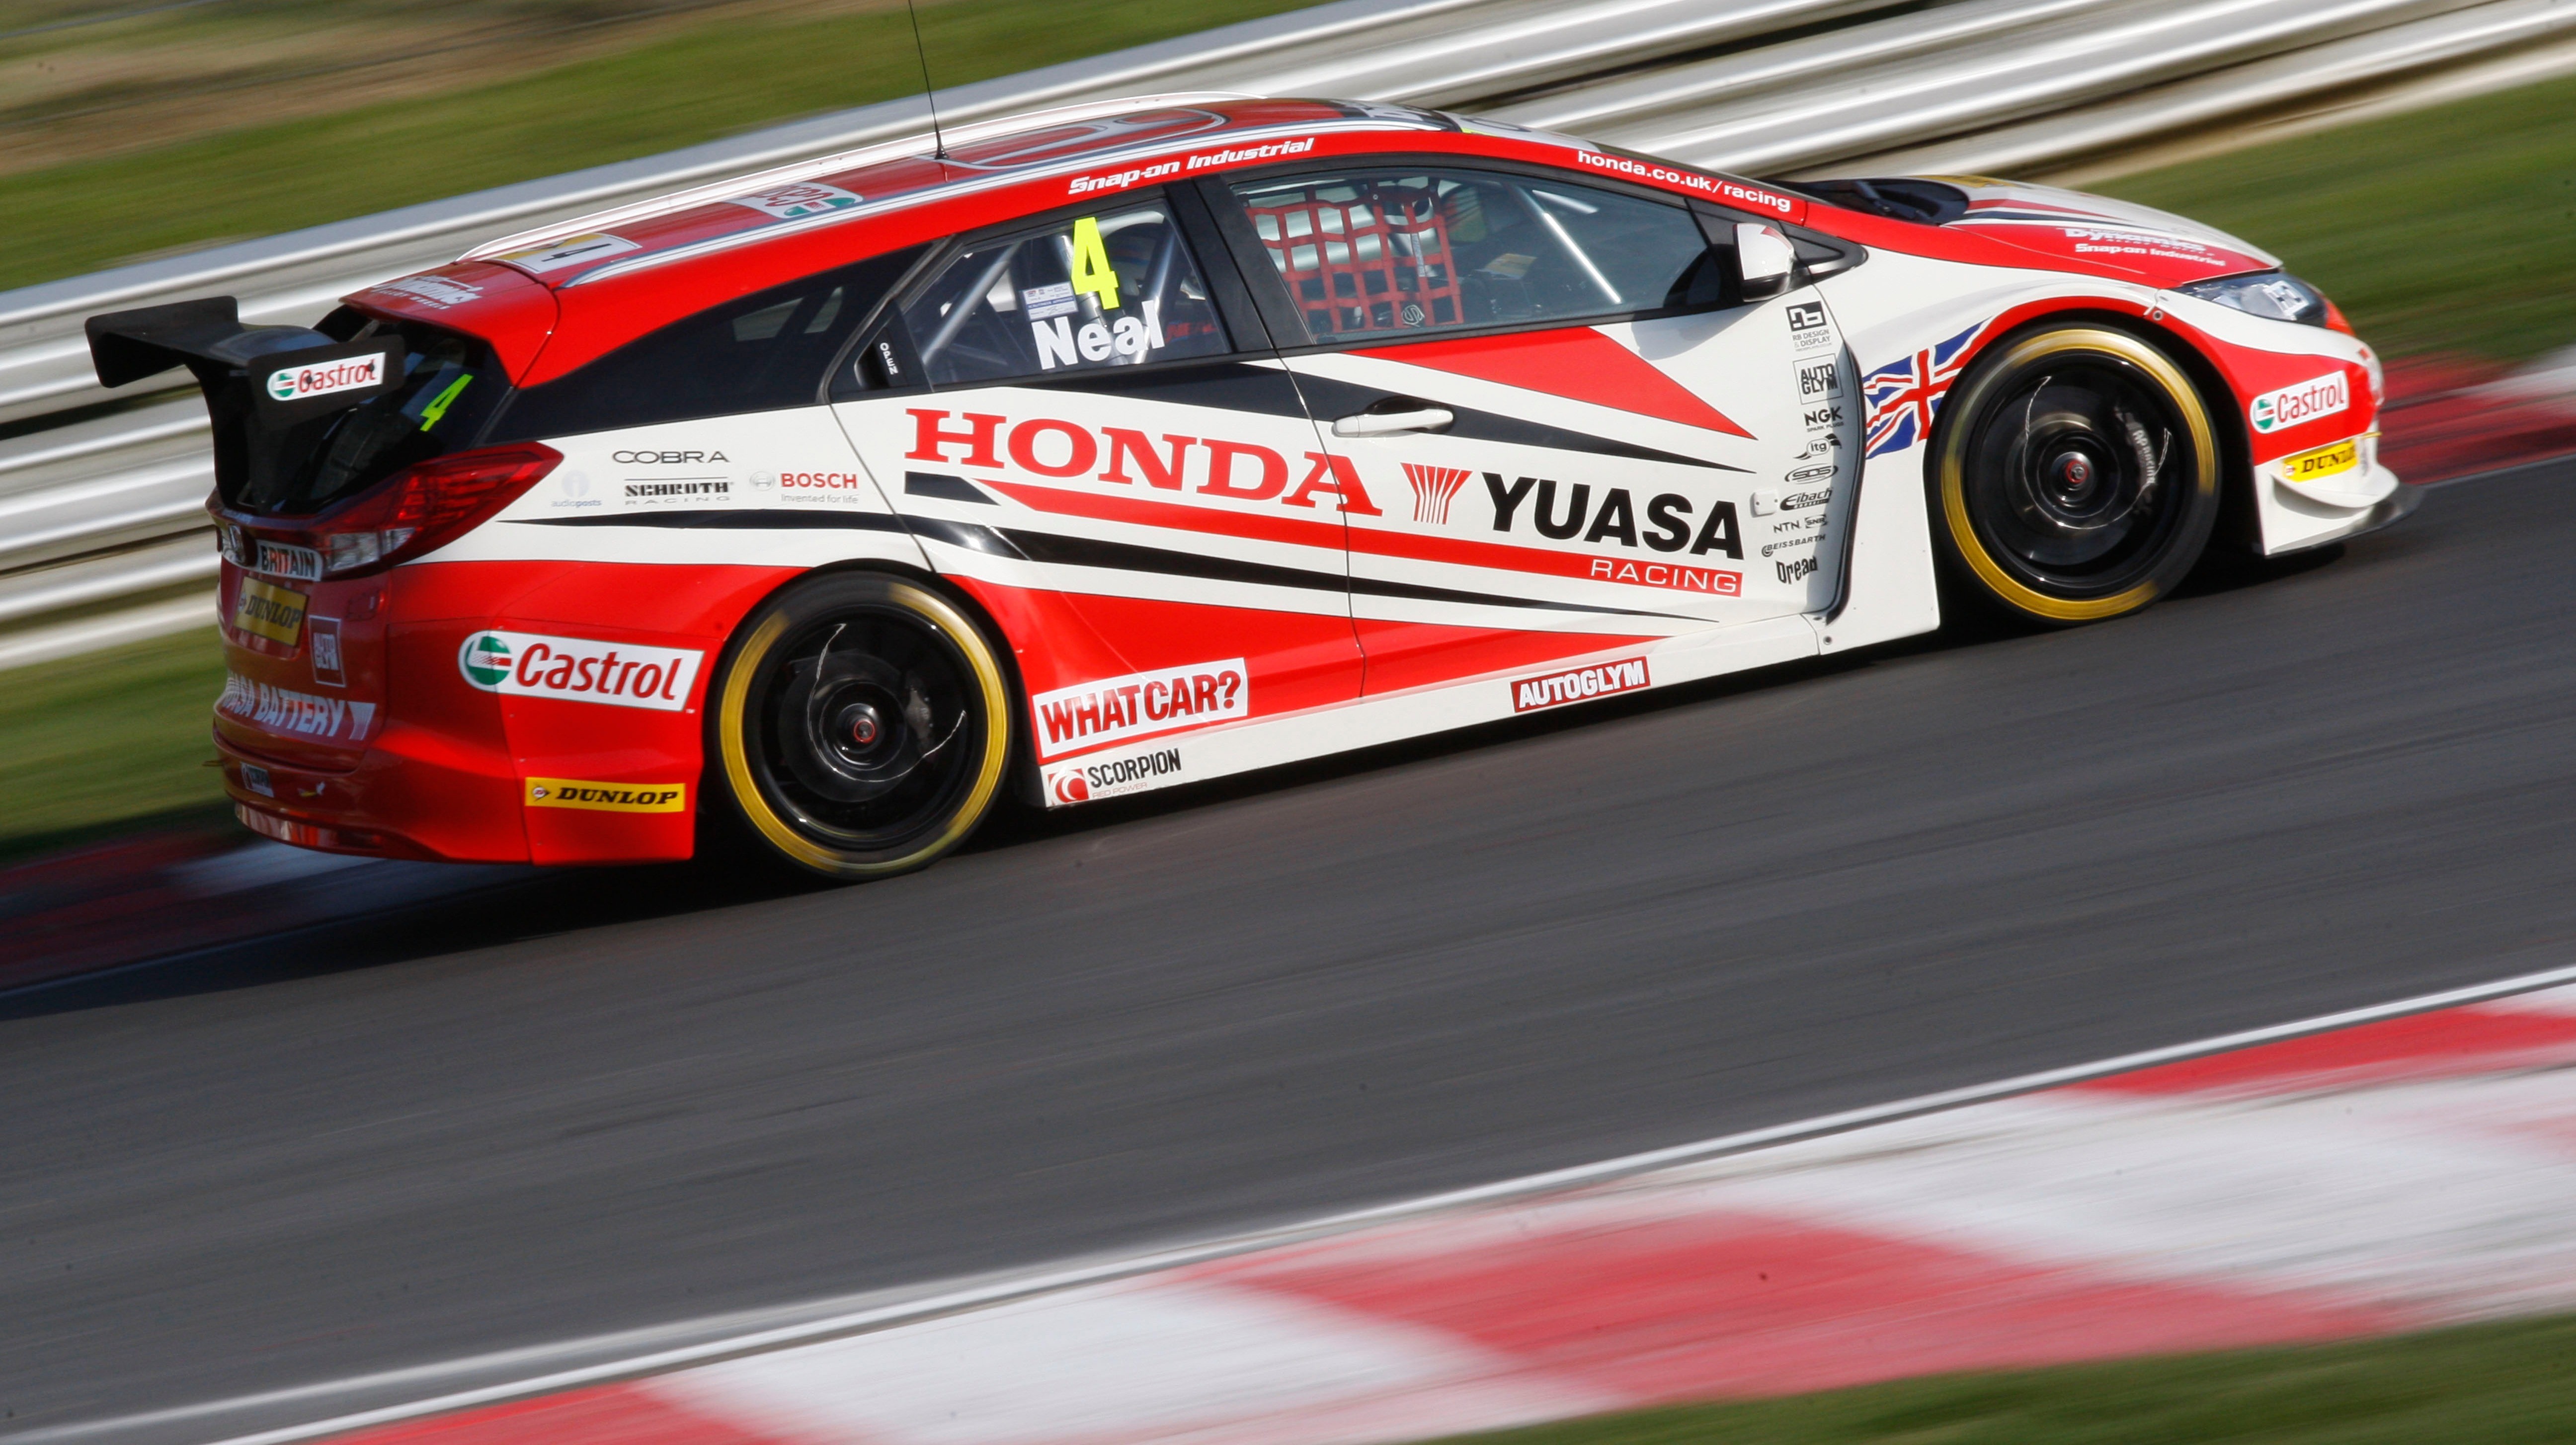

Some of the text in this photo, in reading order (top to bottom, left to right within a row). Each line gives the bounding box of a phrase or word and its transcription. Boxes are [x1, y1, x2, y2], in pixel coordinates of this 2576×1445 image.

[1068, 137, 1314, 195] Snap-on Industrial
[1577, 150, 1791, 213] honda.co.uk/racing
[1070, 216, 1119, 311] 4
[2075, 243, 2146, 254] Snap-on
[1031, 299, 1165, 370] Neal
[1800, 336, 1831, 347] DISPLAY
[1803, 329, 1830, 339] DESIGN
[880, 342, 899, 375] OPEN
[1800, 363, 1836, 383] AUTO
[299, 358, 377, 393] Castrol
[1801, 376, 1839, 395] GLYM
[420, 374, 474, 432] 4
[1804, 406, 1843, 426] NGK
[2277, 378, 2345, 423] Castrol
[612, 450, 730, 464] COBRA
[904, 407, 1383, 517] HONDA
[780, 473, 858, 489] BOSCH
[625, 495, 730, 505] RACING
[781, 493, 858, 504] Invented for life
[1779, 487, 1834, 511] Eibach
[1481, 471, 1744, 561] YUASA
[1773, 520, 1800, 533] NTN
[1764, 534, 1826, 552] BEISSBARTH
[260, 545, 315, 578] BRITAIN
[1590, 558, 1738, 594] RACING
[1775, 555, 1819, 584] Dread
[245, 595, 303, 629] DUNLOP
[515, 642, 684, 701] Castrol
[1519, 660, 1646, 709] AUTOGLYM
[252, 683, 346, 737] BATTERY
[1040, 670, 1241, 744] WHAT CAR?
[1087, 747, 1182, 789] SCORPION
[555, 787, 678, 805] DUNLOP
[1112, 781, 1148, 795] POWER
